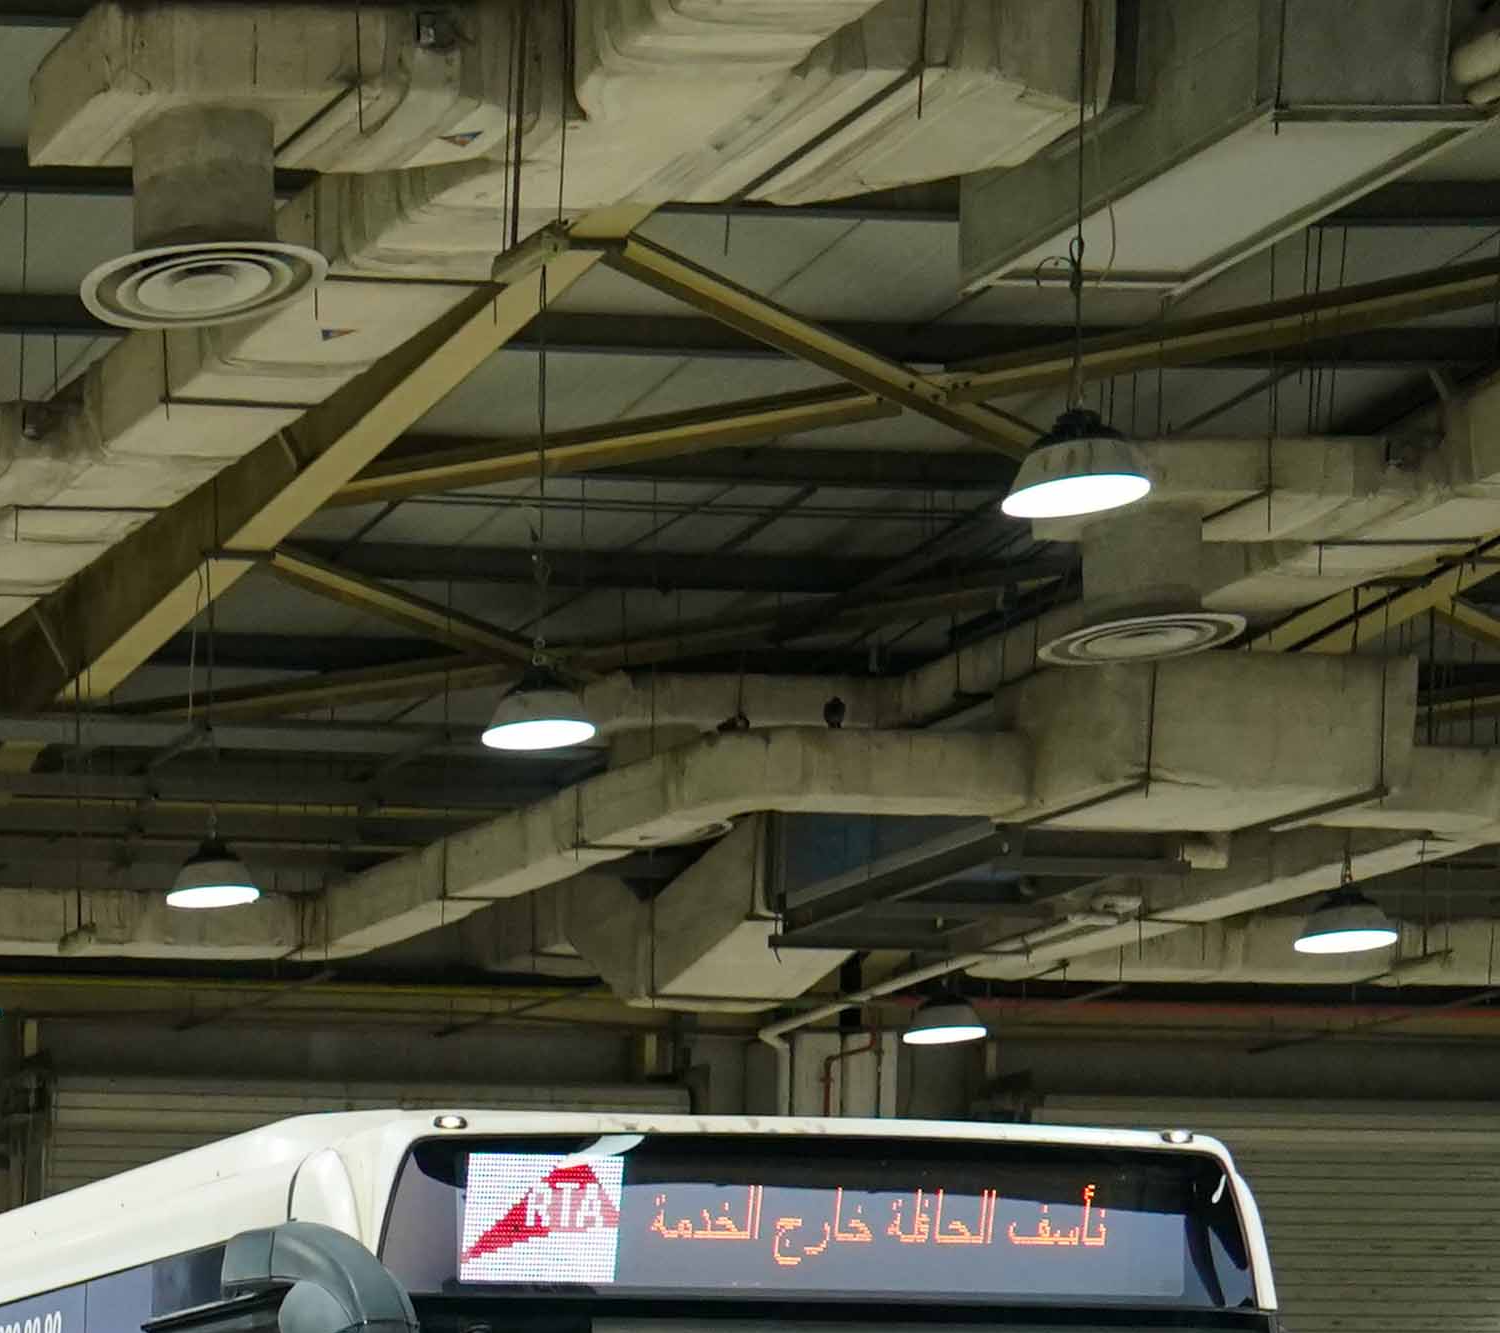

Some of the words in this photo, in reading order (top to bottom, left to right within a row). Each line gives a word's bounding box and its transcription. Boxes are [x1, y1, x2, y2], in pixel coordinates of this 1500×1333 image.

[526, 1182, 604, 1229] RTA
[651, 1184, 763, 1240] الخدمة
[773, 1187, 873, 1264] خارج
[1008, 1184, 1106, 1245] نأسف
